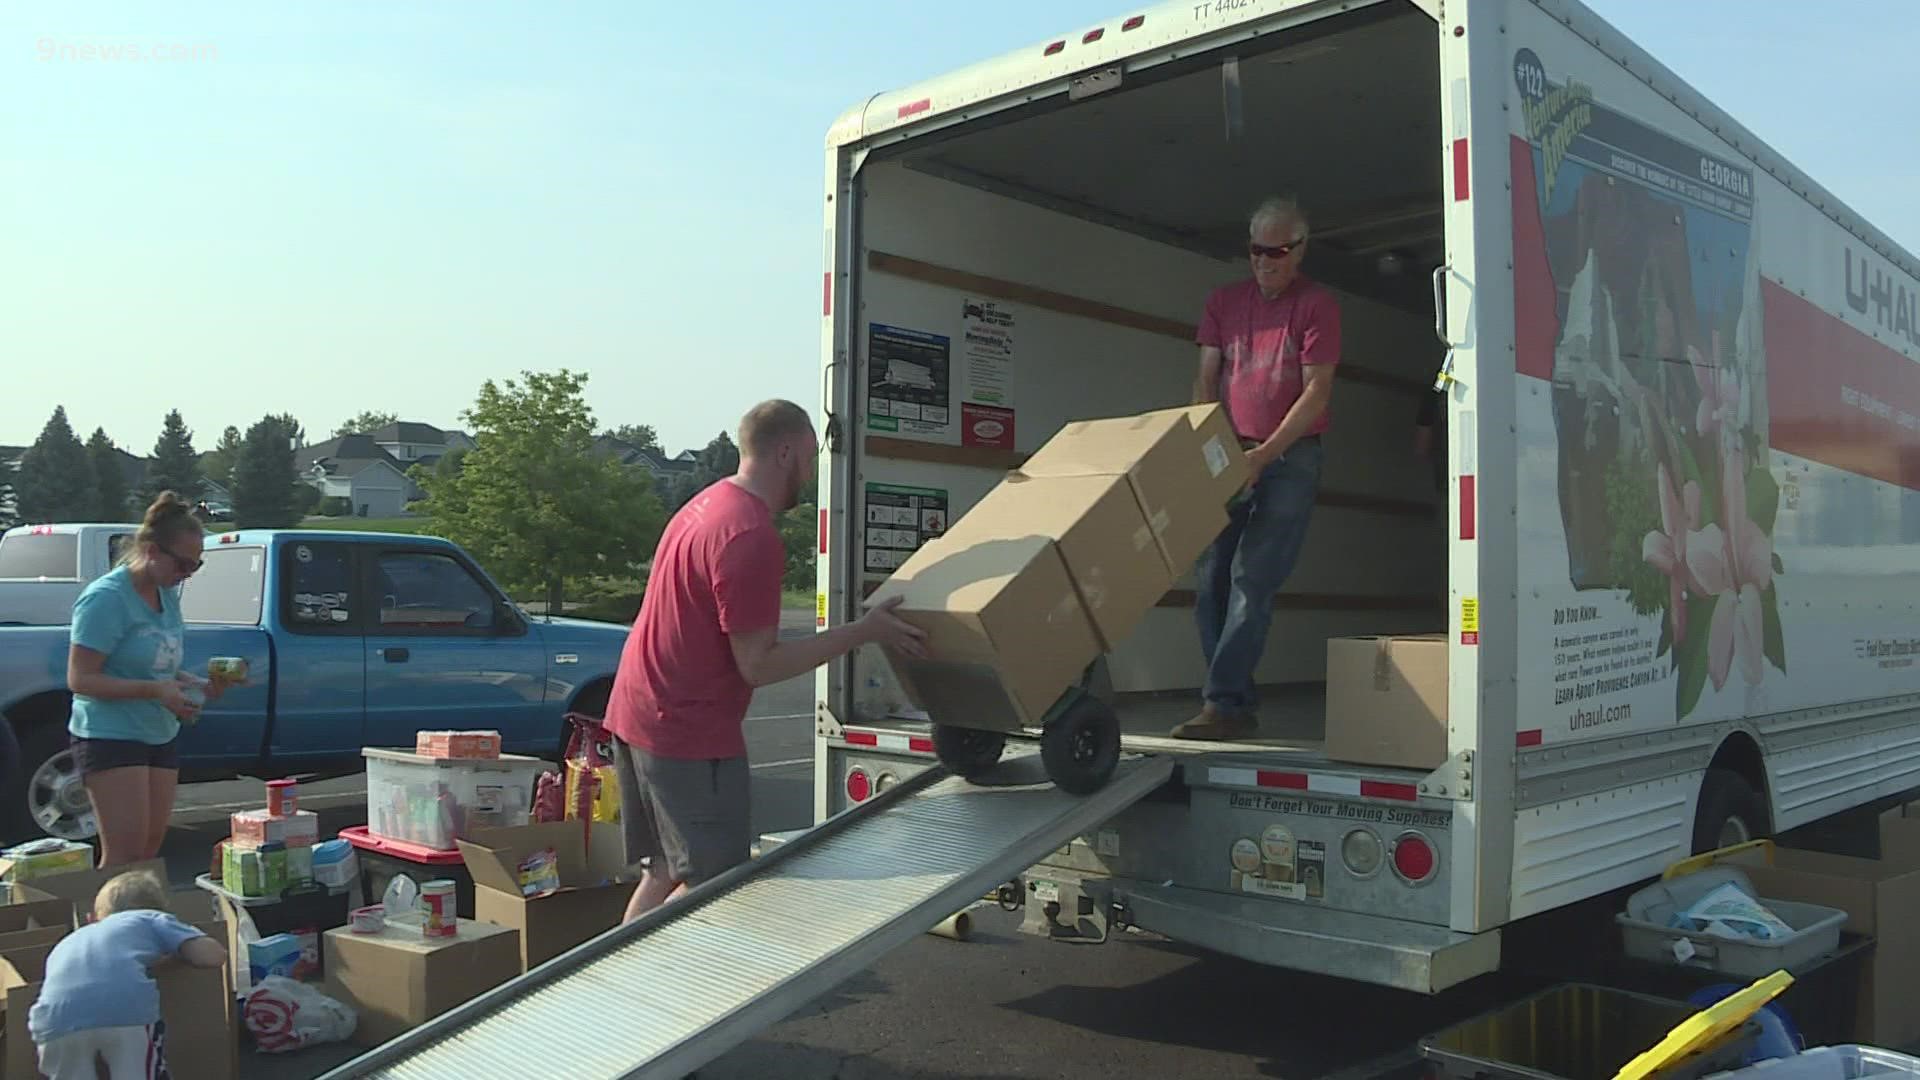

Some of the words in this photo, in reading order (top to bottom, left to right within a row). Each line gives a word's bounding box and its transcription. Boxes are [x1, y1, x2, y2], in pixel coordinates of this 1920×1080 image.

[1194, 2, 1212, 21] TT
[1516, 62, 1543, 98] #122
[1700, 156, 1750, 197] GEORGIA
[1566, 607, 1579, 624] YOU
[1554, 636, 1559, 648] A
[1555, 687, 1574, 706] LEARN
[1575, 682, 1596, 700] ABOUT
[1569, 703, 1632, 731] uhaul.com
[1230, 792, 1262, 807] Don't
[1263, 797, 1302, 814] Forget
[1305, 800, 1334, 814] Your
[1336, 803, 1383, 822] Moving
[1386, 808, 1451, 827] Supplies!
